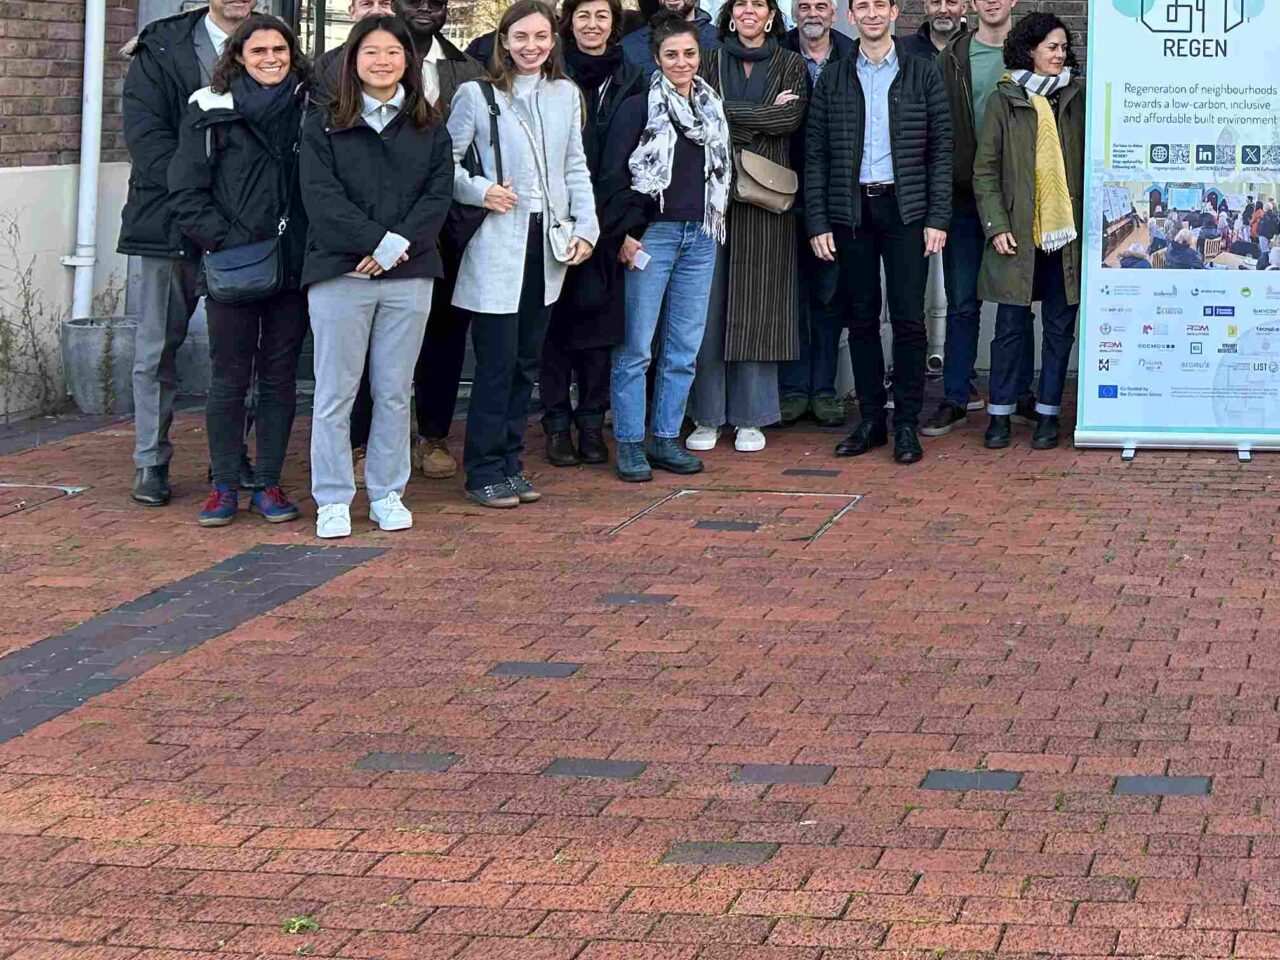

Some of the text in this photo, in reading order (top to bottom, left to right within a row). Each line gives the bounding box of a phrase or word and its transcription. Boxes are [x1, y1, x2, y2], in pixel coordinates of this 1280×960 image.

[1163, 38, 1227, 58] REGEN
[1124, 83, 1278, 97] Regeneration of neighbourhoods
[1123, 99, 1161, 109] towards
[1172, 99, 1228, 110] low-carbon,
[1230, 100, 1271, 110] inclusive
[1123, 113, 1277, 125] and affordable built environment
[1253, 363, 1267, 371] LIST
